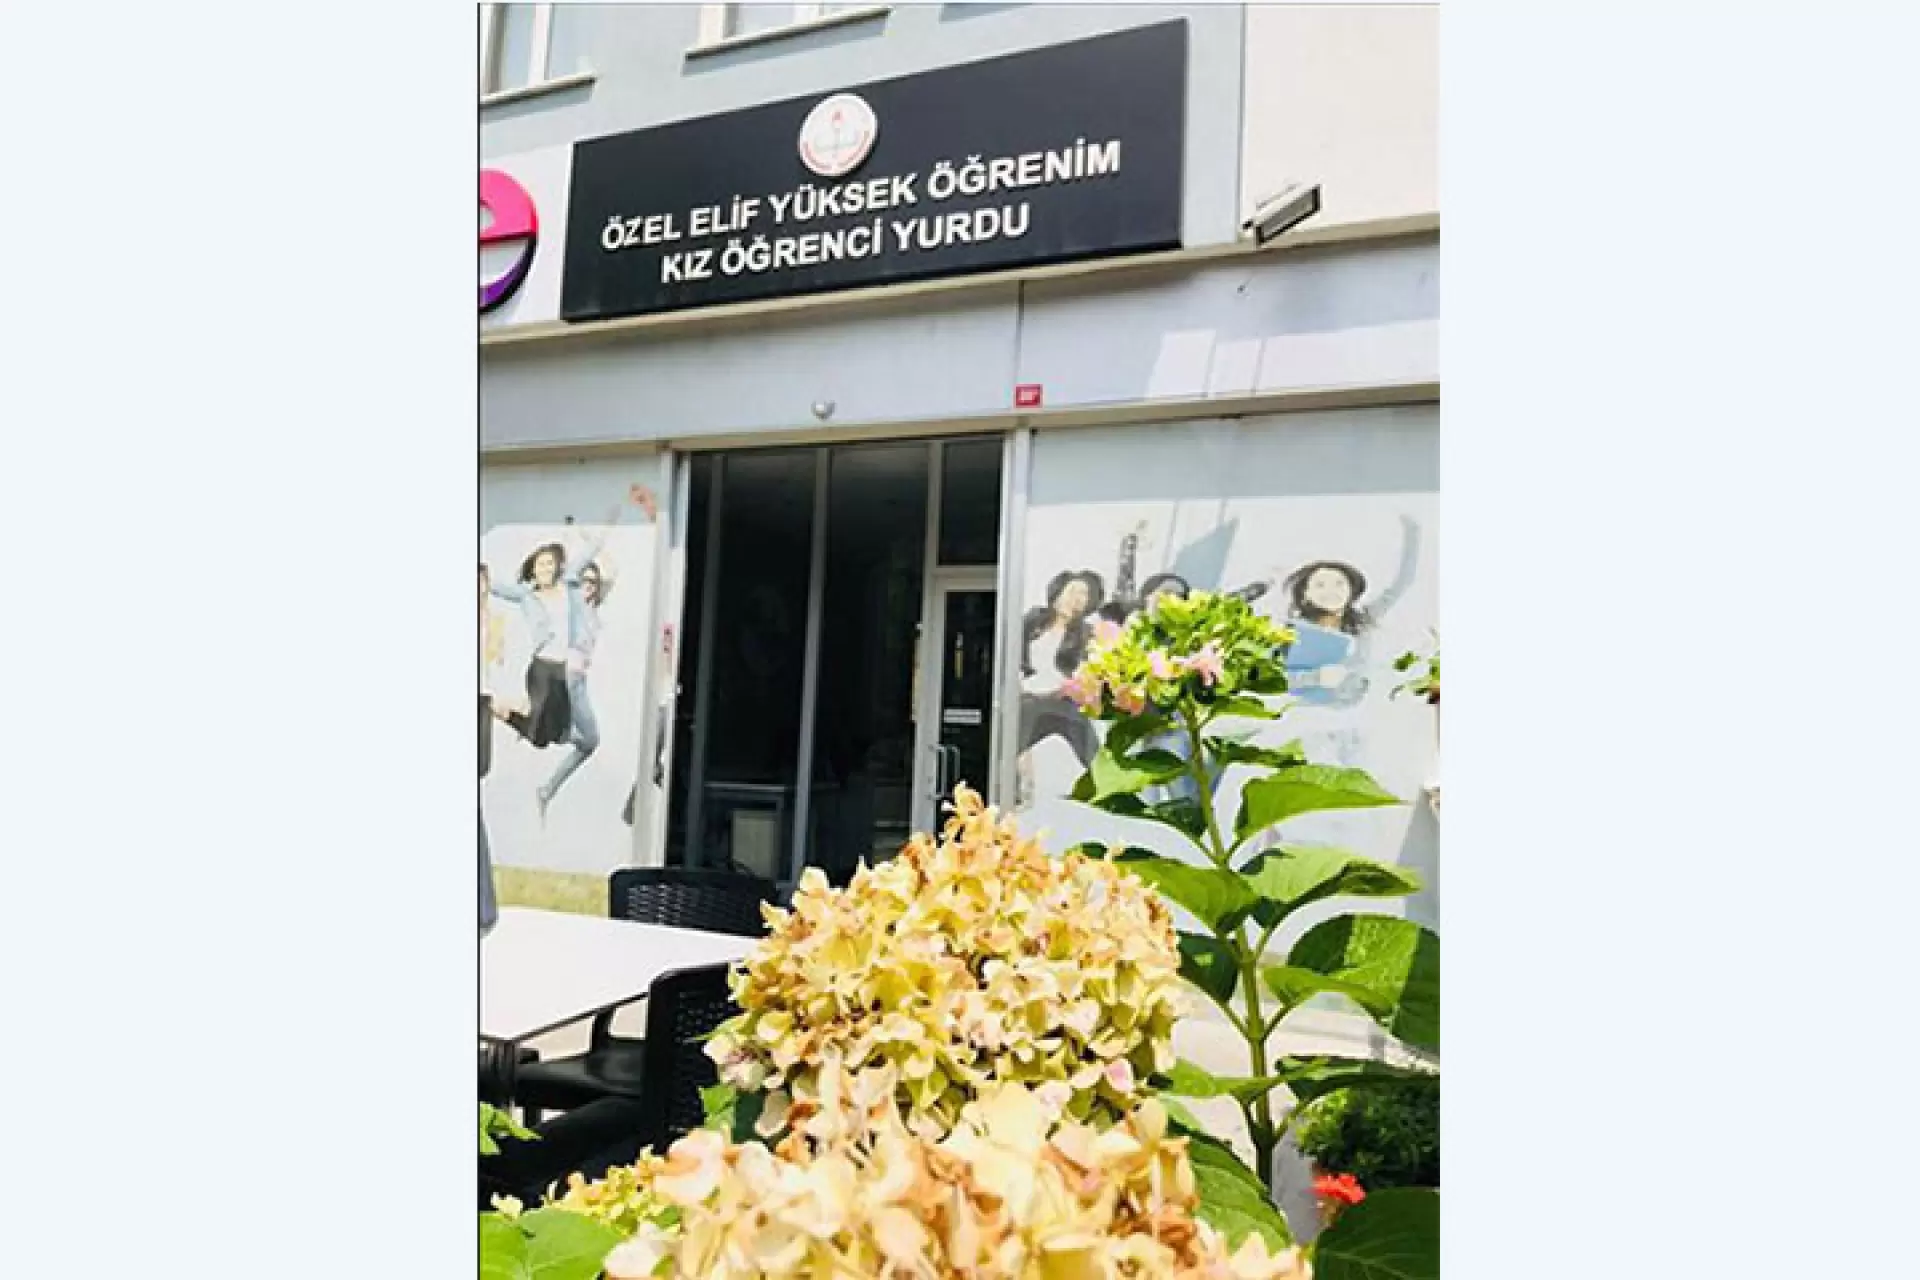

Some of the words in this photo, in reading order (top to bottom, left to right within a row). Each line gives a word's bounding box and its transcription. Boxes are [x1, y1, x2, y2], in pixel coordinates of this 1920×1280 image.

[602, 214, 682, 249] ÖZEL
[690, 194, 760, 237] ELİF
[767, 183, 917, 224] YÜKSEK
[928, 137, 1121, 199] ÖĞRENİM
[661, 248, 713, 283] KIZ
[720, 234, 883, 275] ÖĞRENCİ
[890, 202, 1030, 250] YURDU
